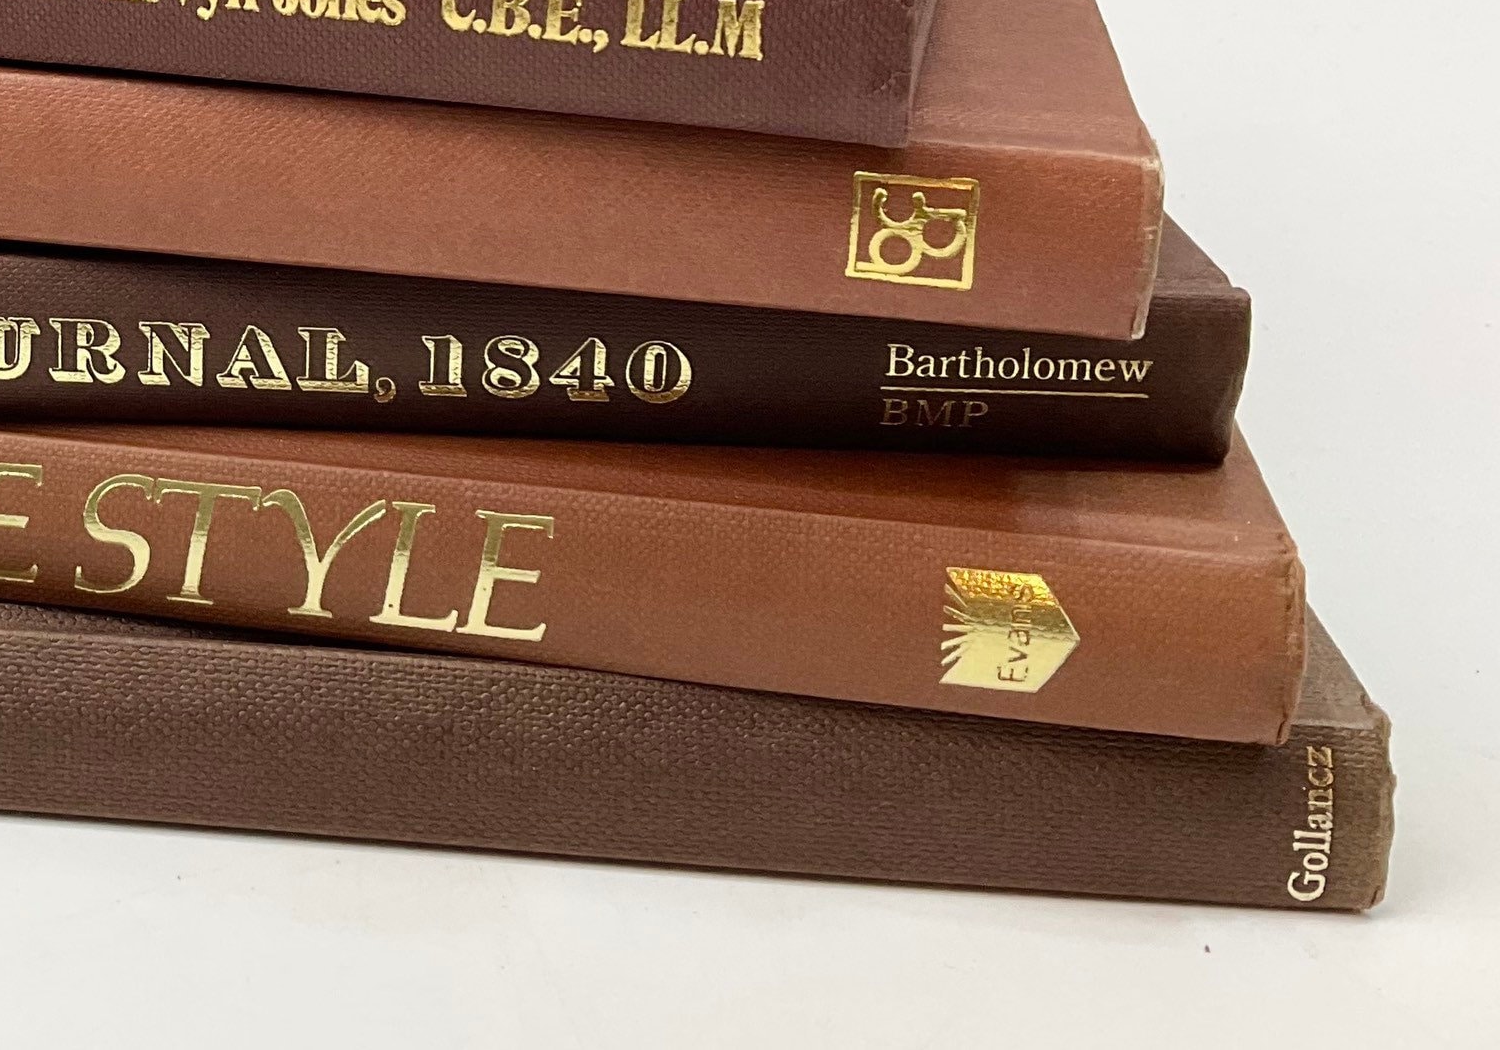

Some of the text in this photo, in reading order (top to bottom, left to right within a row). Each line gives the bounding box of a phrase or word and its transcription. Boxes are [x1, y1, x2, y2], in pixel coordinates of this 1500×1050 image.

[418, 334, 695, 405] 1840
[885, 343, 1154, 382] Bartholomew
[879, 398, 989, 427] BMP
[75, 472, 555, 643] STYLE
[997, 583, 1035, 682] Evans
[1287, 745, 1334, 902] Gollancz
